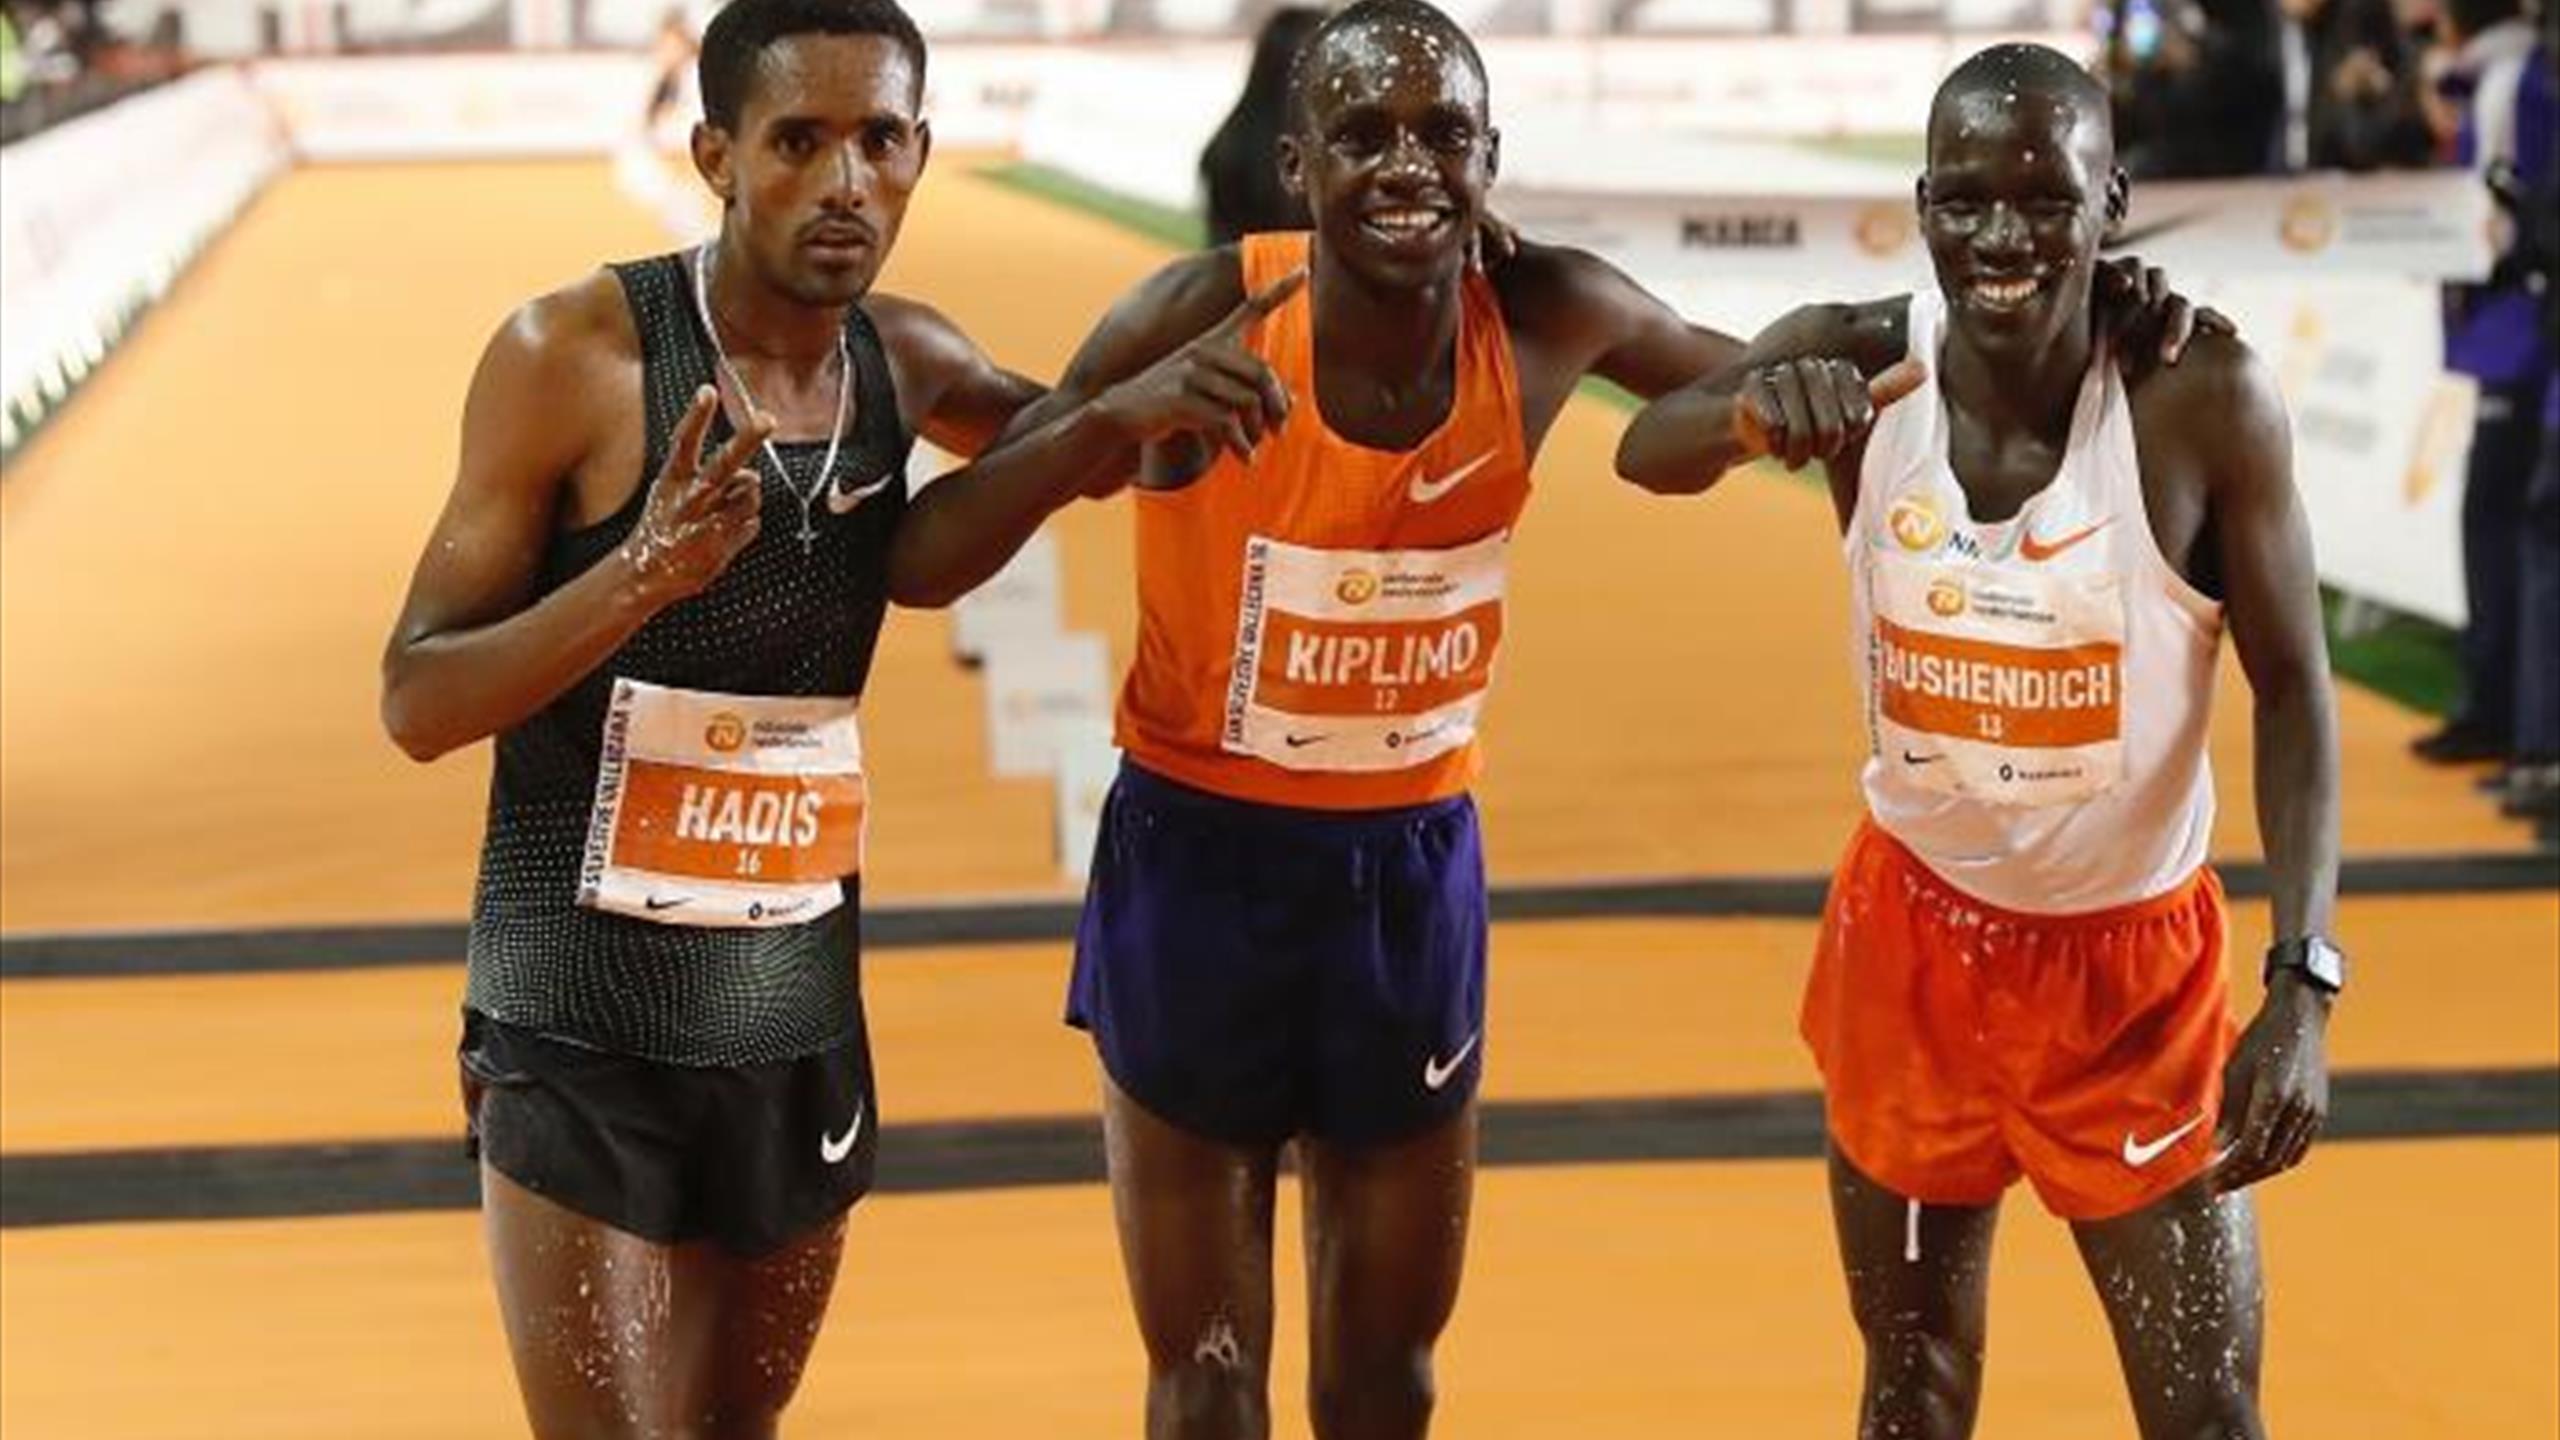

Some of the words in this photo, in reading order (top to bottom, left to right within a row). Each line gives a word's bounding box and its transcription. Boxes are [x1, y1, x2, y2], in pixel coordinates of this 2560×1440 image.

[1286, 623, 1478, 684] KIPLIMO
[676, 783, 823, 847] HADIS
[735, 849, 762, 875] 16
